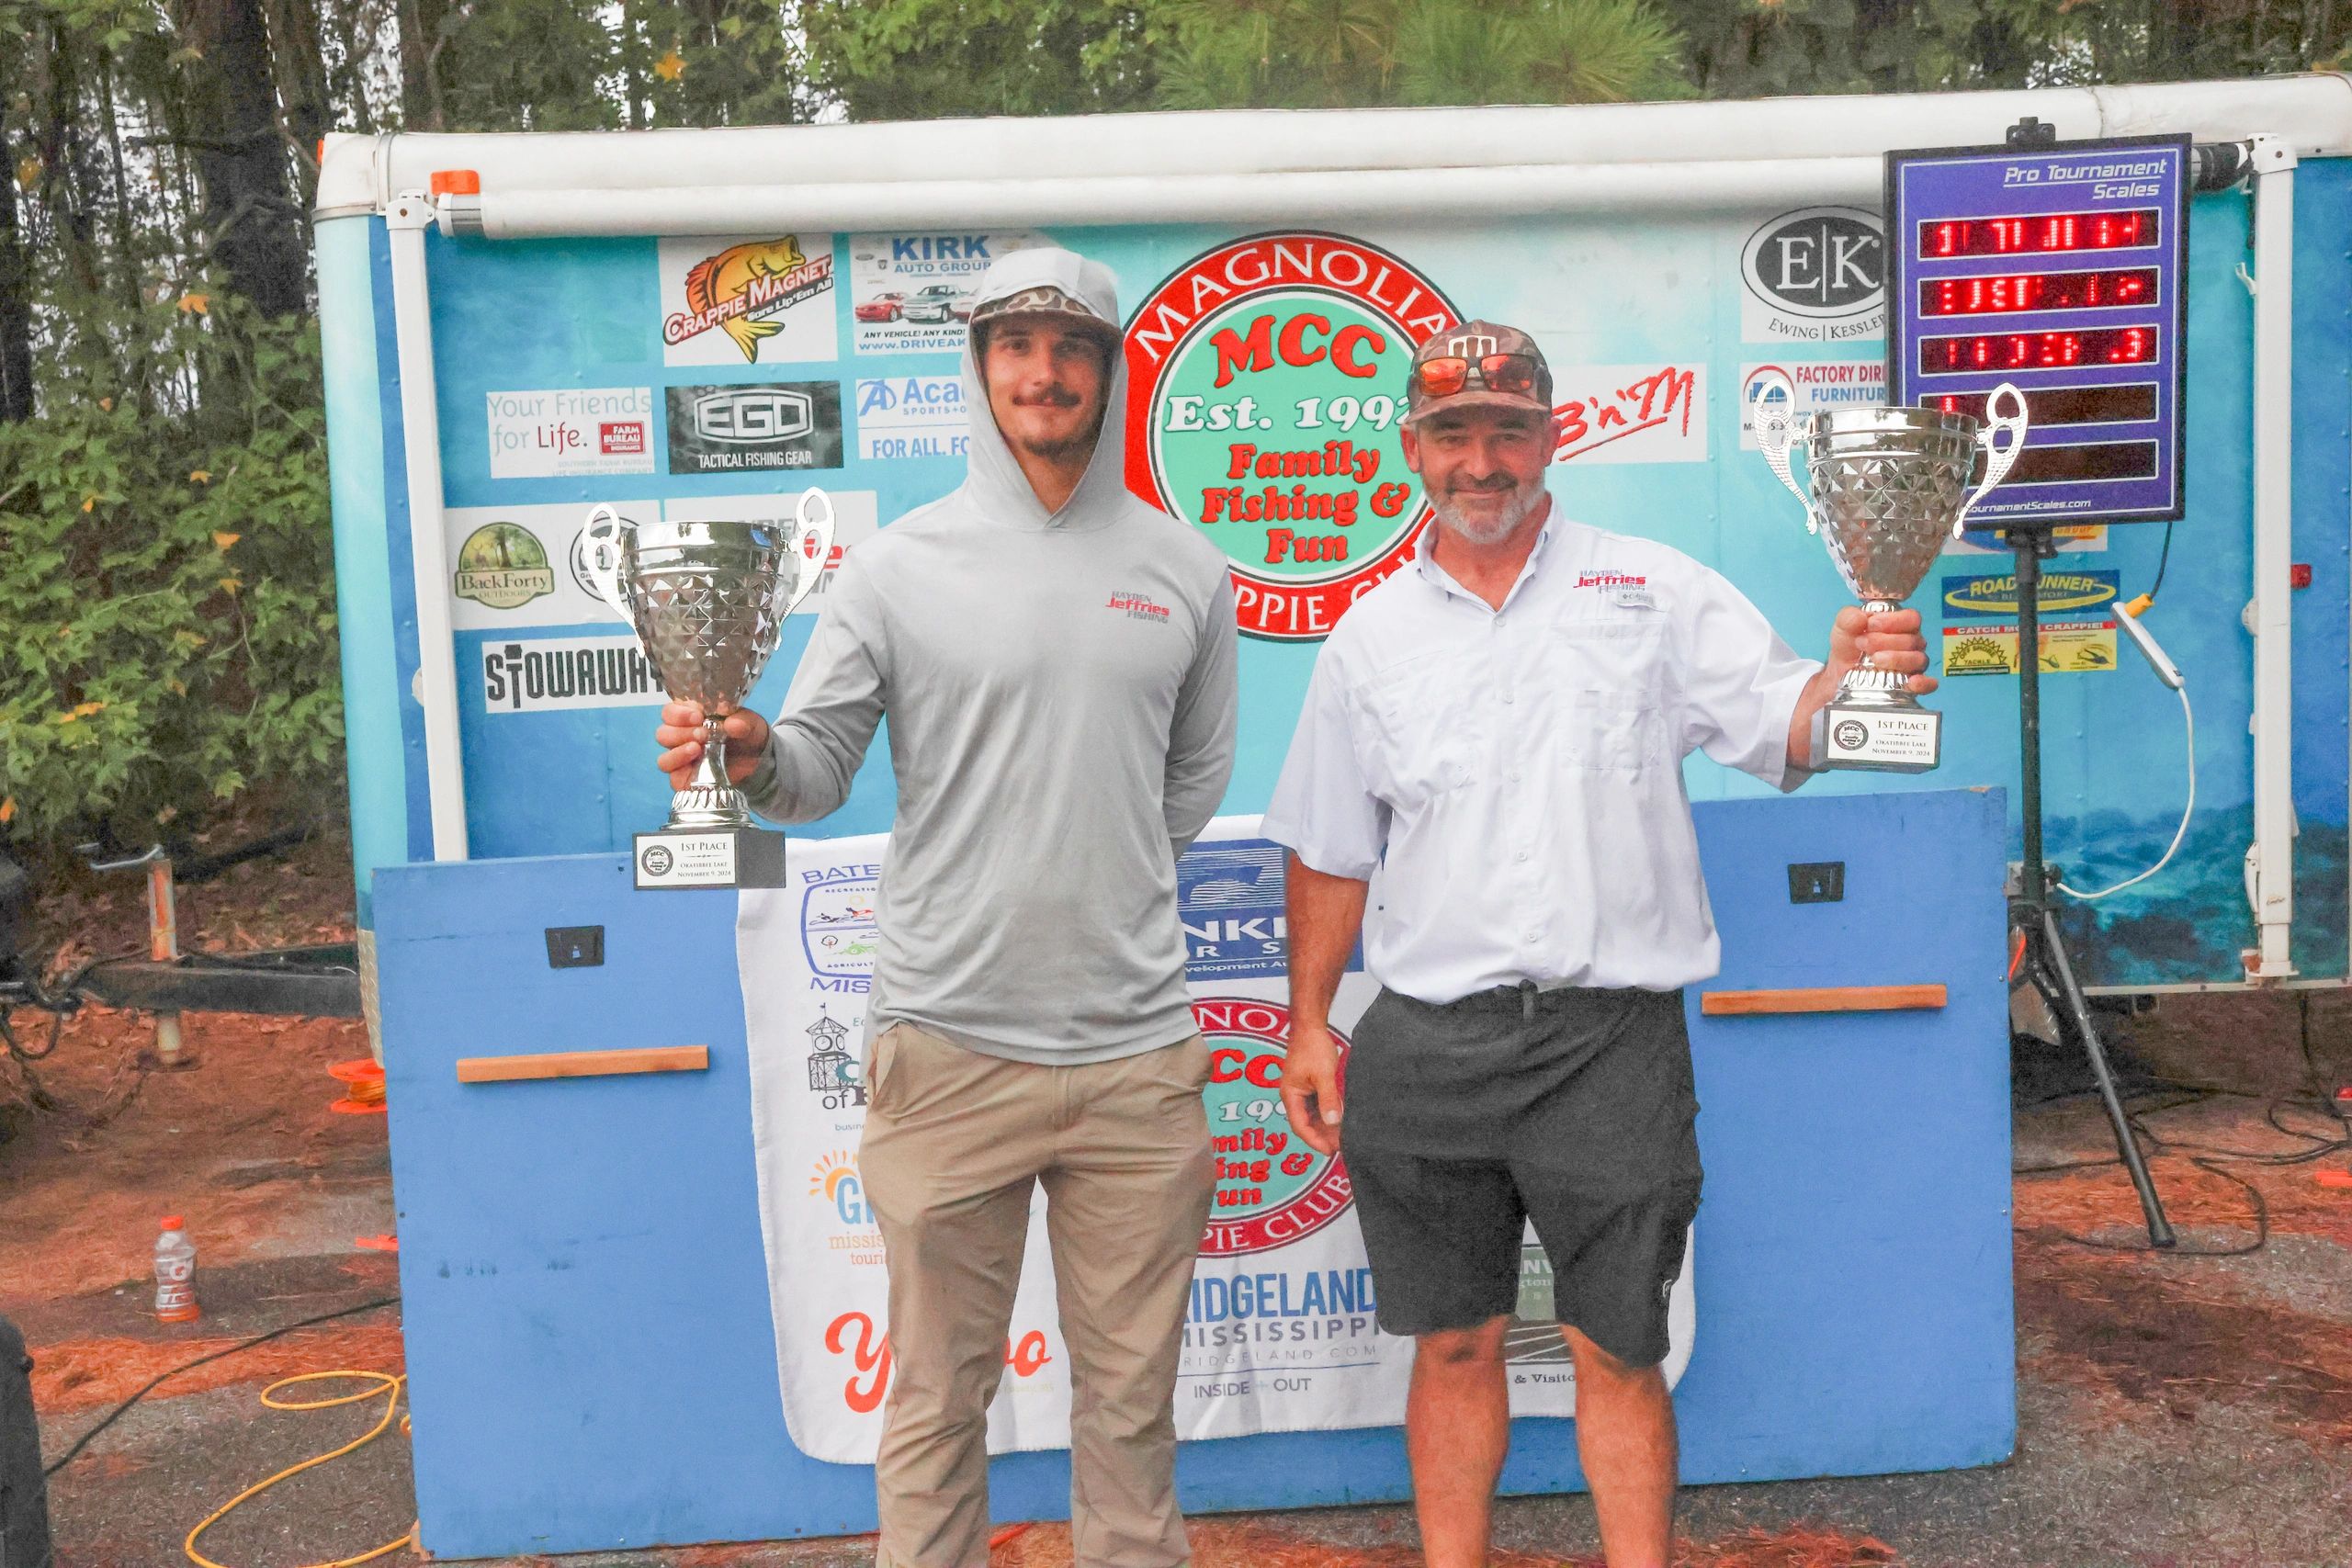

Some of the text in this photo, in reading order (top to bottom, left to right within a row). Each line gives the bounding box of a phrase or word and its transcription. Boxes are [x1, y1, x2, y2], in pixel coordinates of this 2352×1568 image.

[2004, 159, 2166, 183] Pro Tournament
[2092, 183, 2160, 199] Scales
[892, 235, 990, 261] KIRK
[894, 262, 991, 274] AUTO GROUP
[663, 254, 831, 345] CRAPPIE MAGNET
[1135, 243, 1448, 364] MAGNOLIA
[1769, 318, 1819, 339] EWING
[859, 338, 966, 351] www.DRIVEAK
[1210, 313, 1385, 388] MCC
[1797, 366, 1854, 383] FACTORY
[903, 378, 961, 404] Aca
[1812, 386, 1885, 403] FURNITUR
[487, 388, 652, 418] Your Friends
[903, 404, 967, 416] SPORTS+O
[1165, 396, 1273, 432] Est.
[603, 434, 640, 444] BUREAU
[613, 425, 640, 434] FARM
[493, 422, 588, 457] for Life.
[872, 435, 970, 458] FOR ALL. FO
[698, 450, 812, 468] TACTICAL FISHING GEAR
[1227, 440, 1380, 483] Family
[1200, 482, 1410, 526] Fishing &
[1968, 500, 2091, 513] ournamentScales.com
[1264, 528, 1348, 563] Fun
[1573, 575, 1646, 588] Jeffries
[2037, 574, 2096, 592] UNNER
[1105, 597, 1170, 616] Jeffries
[1236, 585, 1329, 631] PPIE
[1127, 610, 1168, 624] FISHING
[1957, 626, 2000, 635] CATCH
[1878, 720, 1928, 731] 1ST PLACE
[1872, 748, 1906, 756] NOVEMBER
[681, 841, 728, 852] 1ST PLACE
[802, 864, 882, 884] BATE
[1184, 962, 1267, 973] velopment
[809, 976, 871, 994] MIS
[822, 1089, 850, 1110] of
[1211, 1128, 1287, 1156] mily
[1215, 1153, 1313, 1182] ing &
[1217, 1188, 1262, 1207] un
[1264, 1174, 1352, 1238] CLUB
[829, 1231, 885, 1250] missis
[851, 1251, 886, 1265] touri
[1185, 1268, 1377, 1323] IDGELAND
[1514, 1373, 1575, 1383] & Visito
[1194, 1378, 1311, 1398] INSIDE OUT
